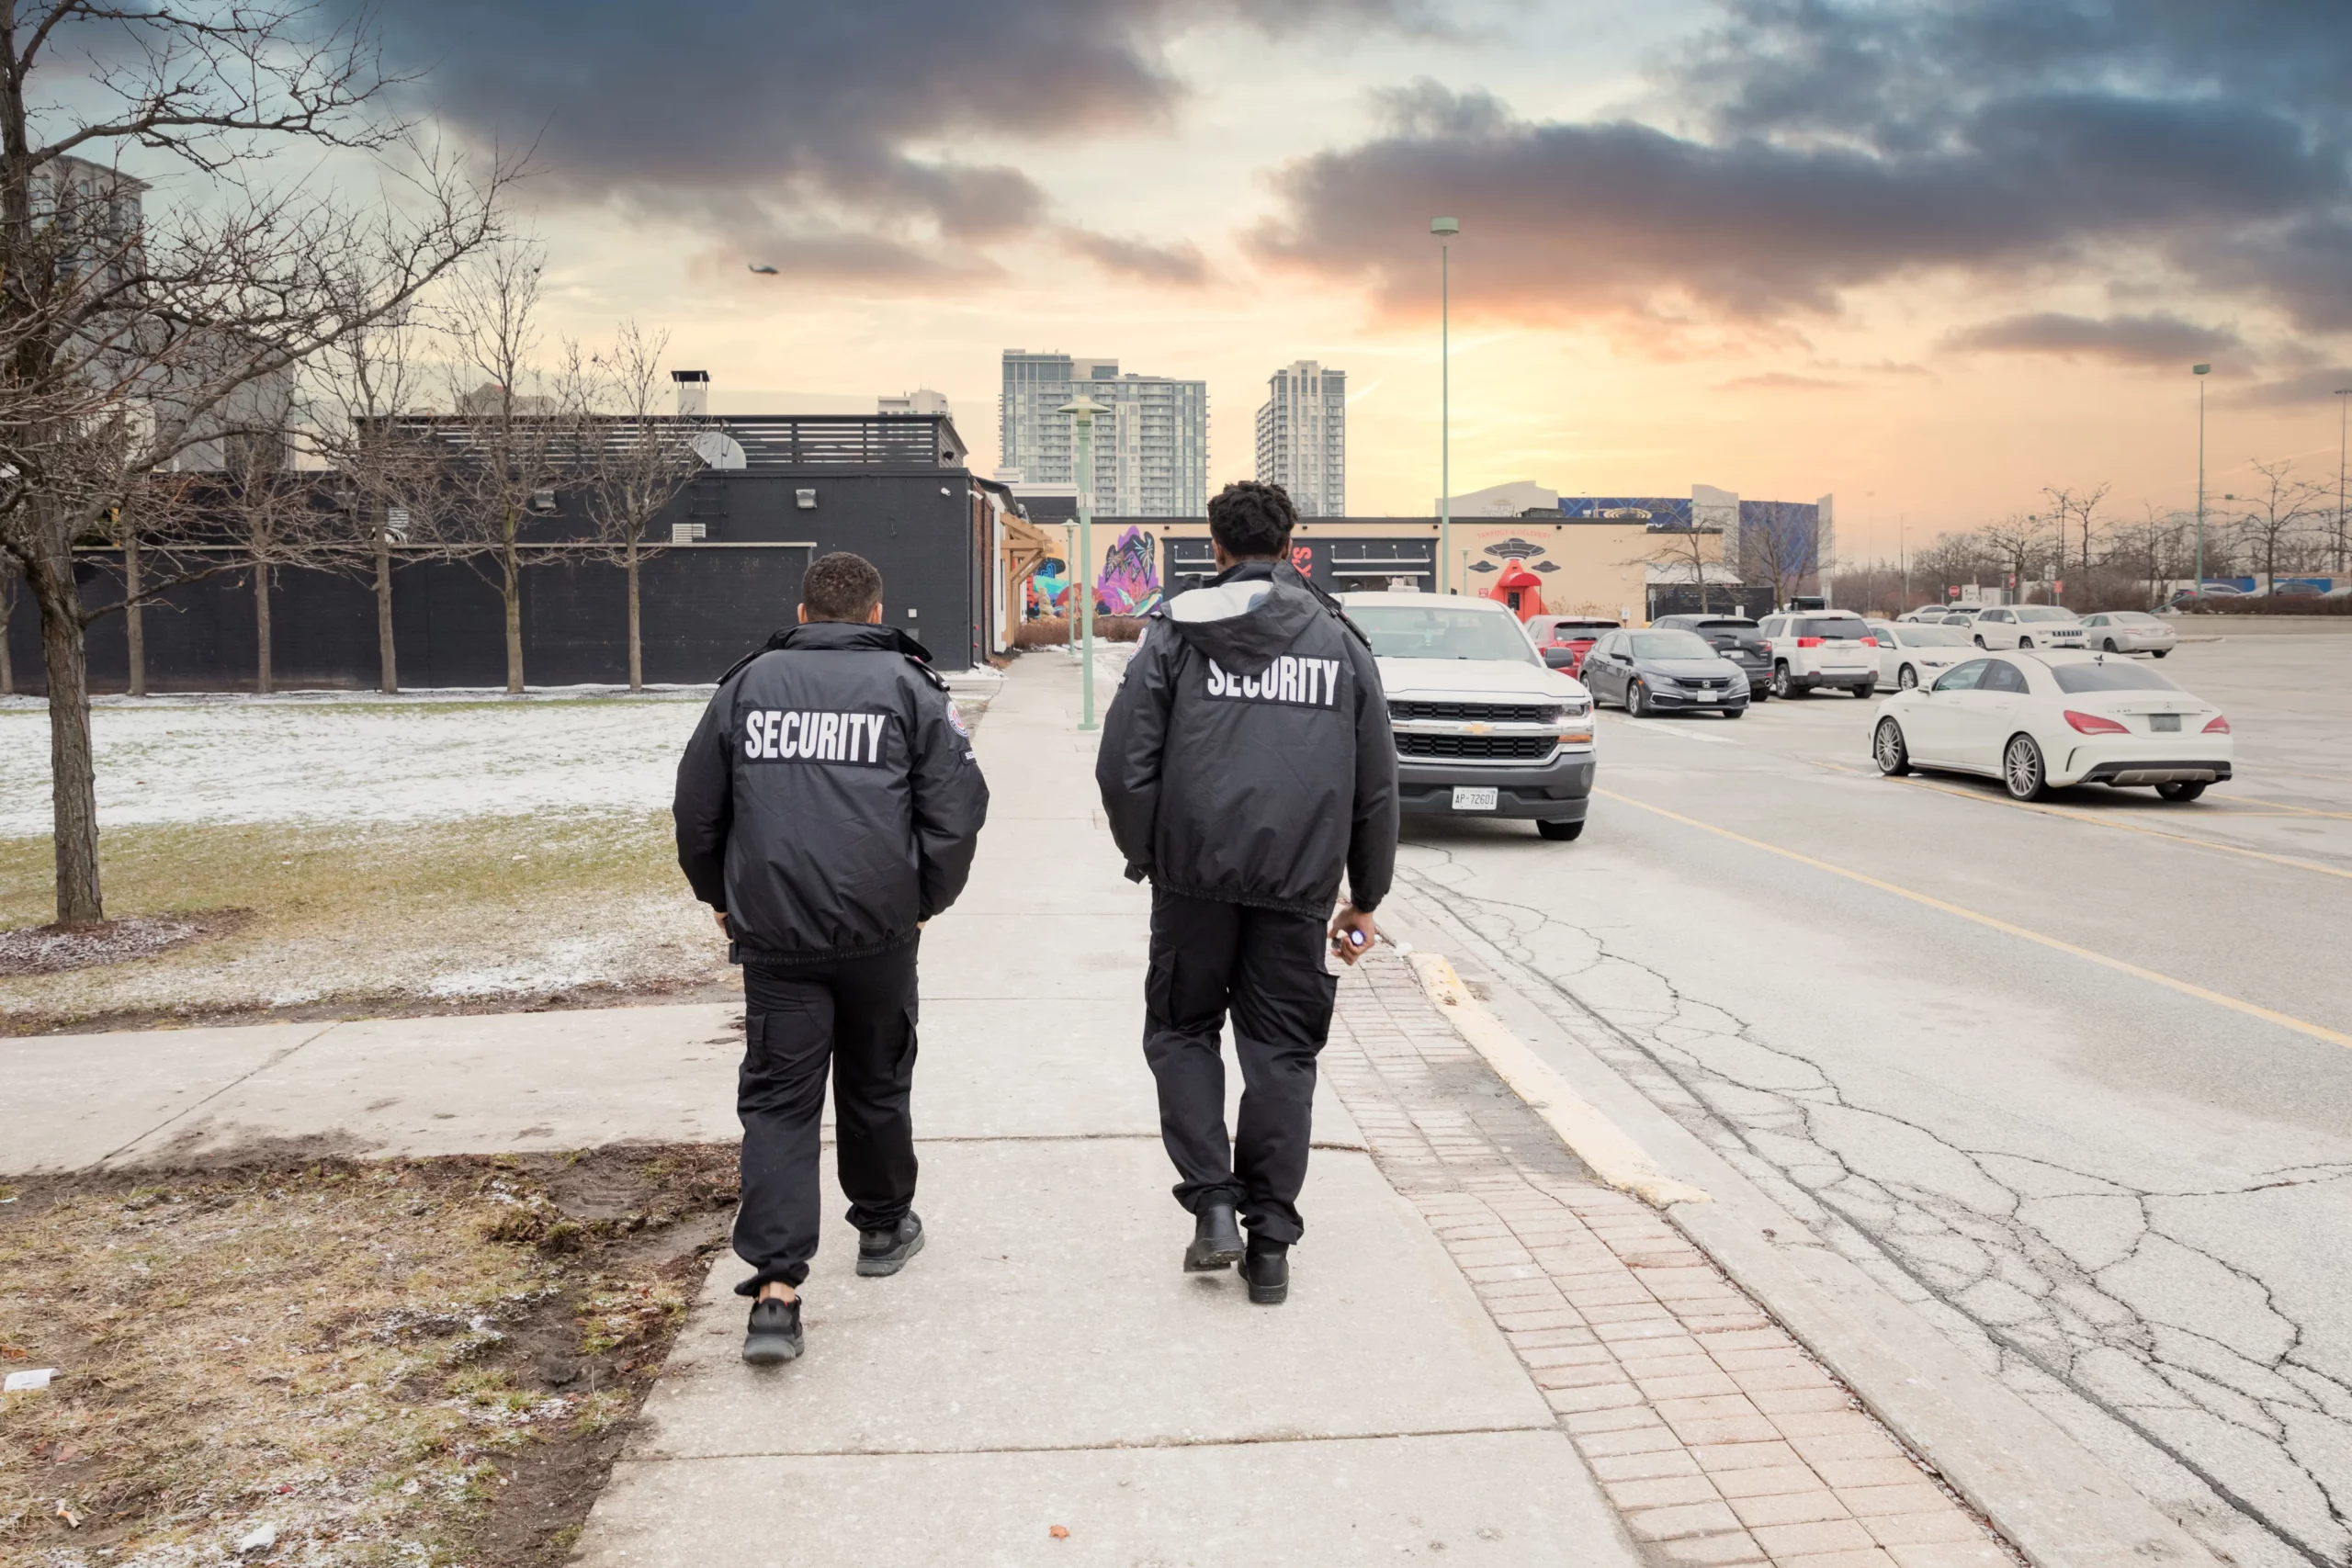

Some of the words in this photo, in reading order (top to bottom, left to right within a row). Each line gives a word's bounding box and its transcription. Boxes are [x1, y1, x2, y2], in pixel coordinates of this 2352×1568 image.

[1477, 529, 1508, 538] TAKEOUT
[1517, 530, 1551, 538] DELIVERY
[745, 710, 886, 763] SECURITY
